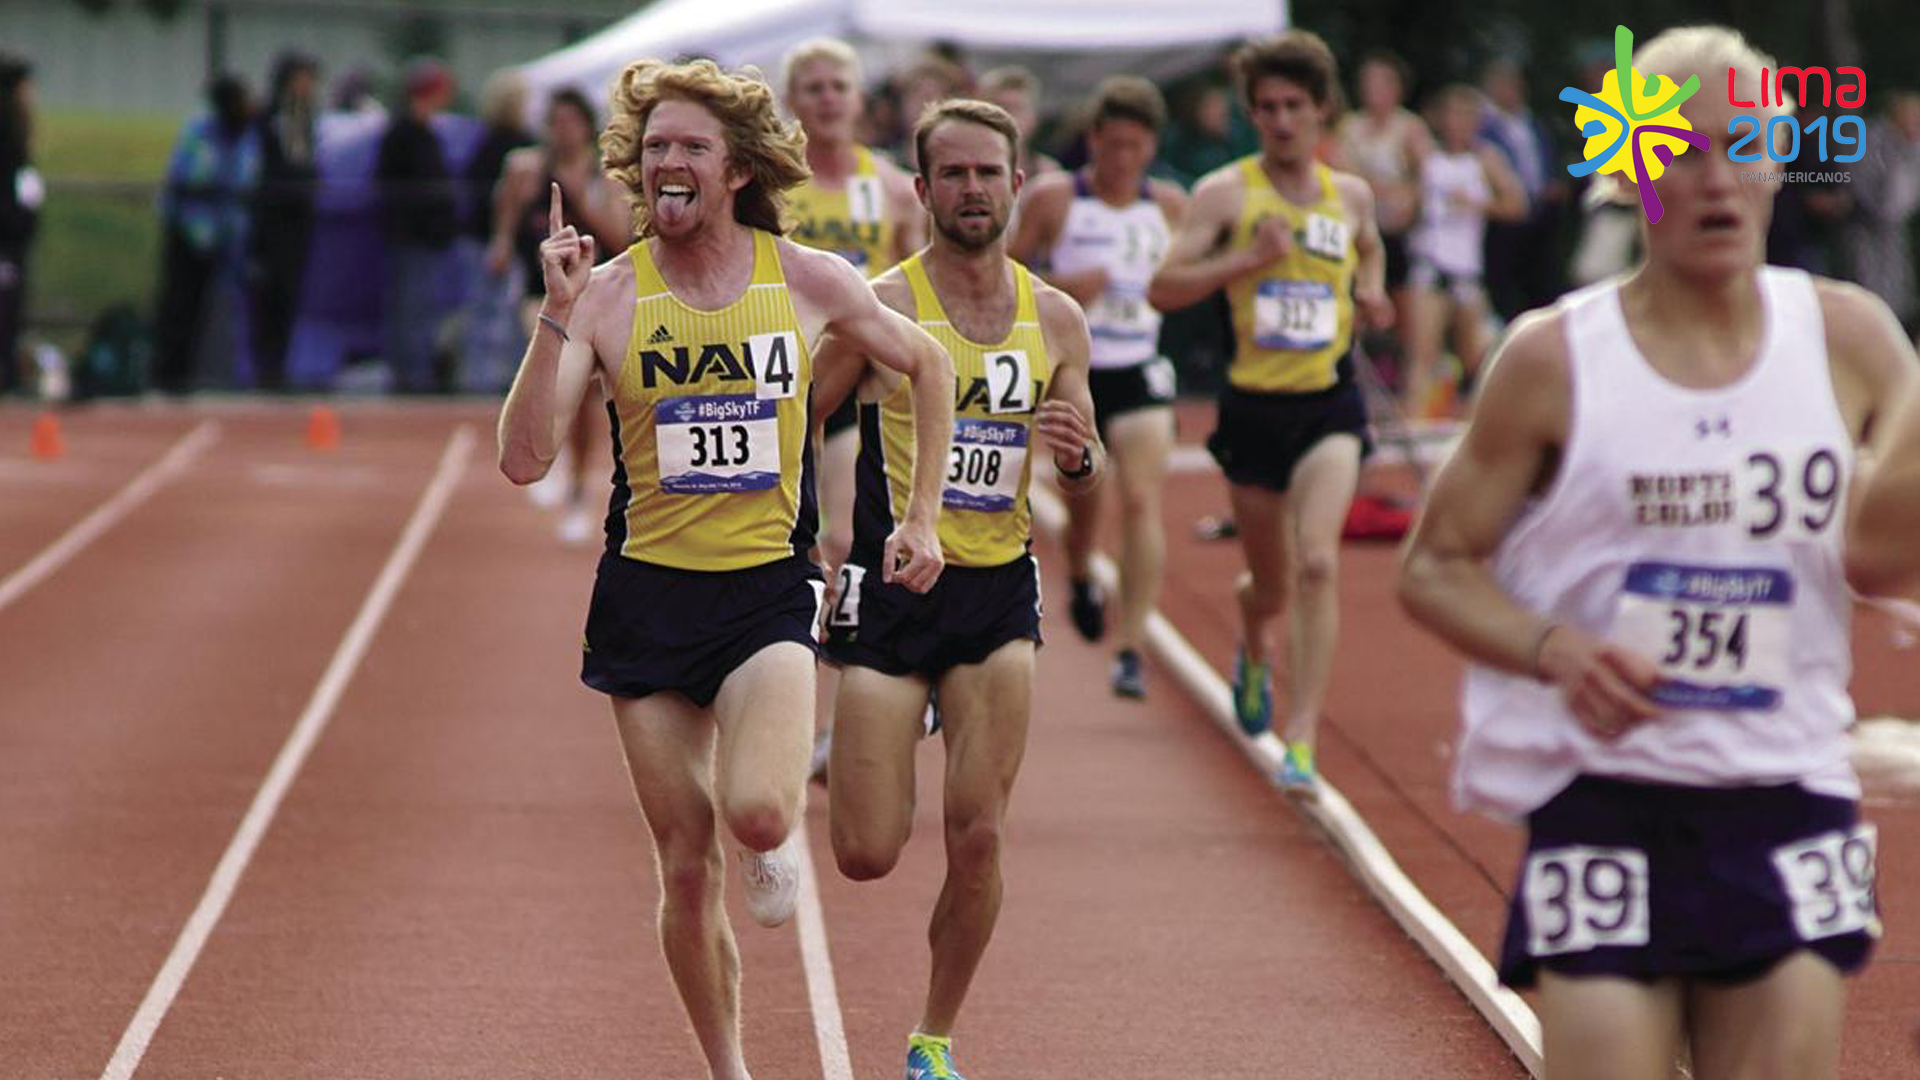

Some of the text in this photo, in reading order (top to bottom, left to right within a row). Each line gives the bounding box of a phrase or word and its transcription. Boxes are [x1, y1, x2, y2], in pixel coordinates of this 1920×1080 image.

[765, 336, 793, 394] 4
[995, 355, 1023, 409] 2
[699, 401, 760, 419] #BigSkyTF
[963, 426, 1016, 443] #BigSkyTF
[689, 425, 750, 467] 313
[948, 446, 1001, 487] 308
[1748, 449, 1839, 538] 39
[835, 568, 852, 622] 2
[1662, 609, 1747, 670] 354
[1542, 857, 1630, 943] 39
[1797, 838, 1875, 927] 39
